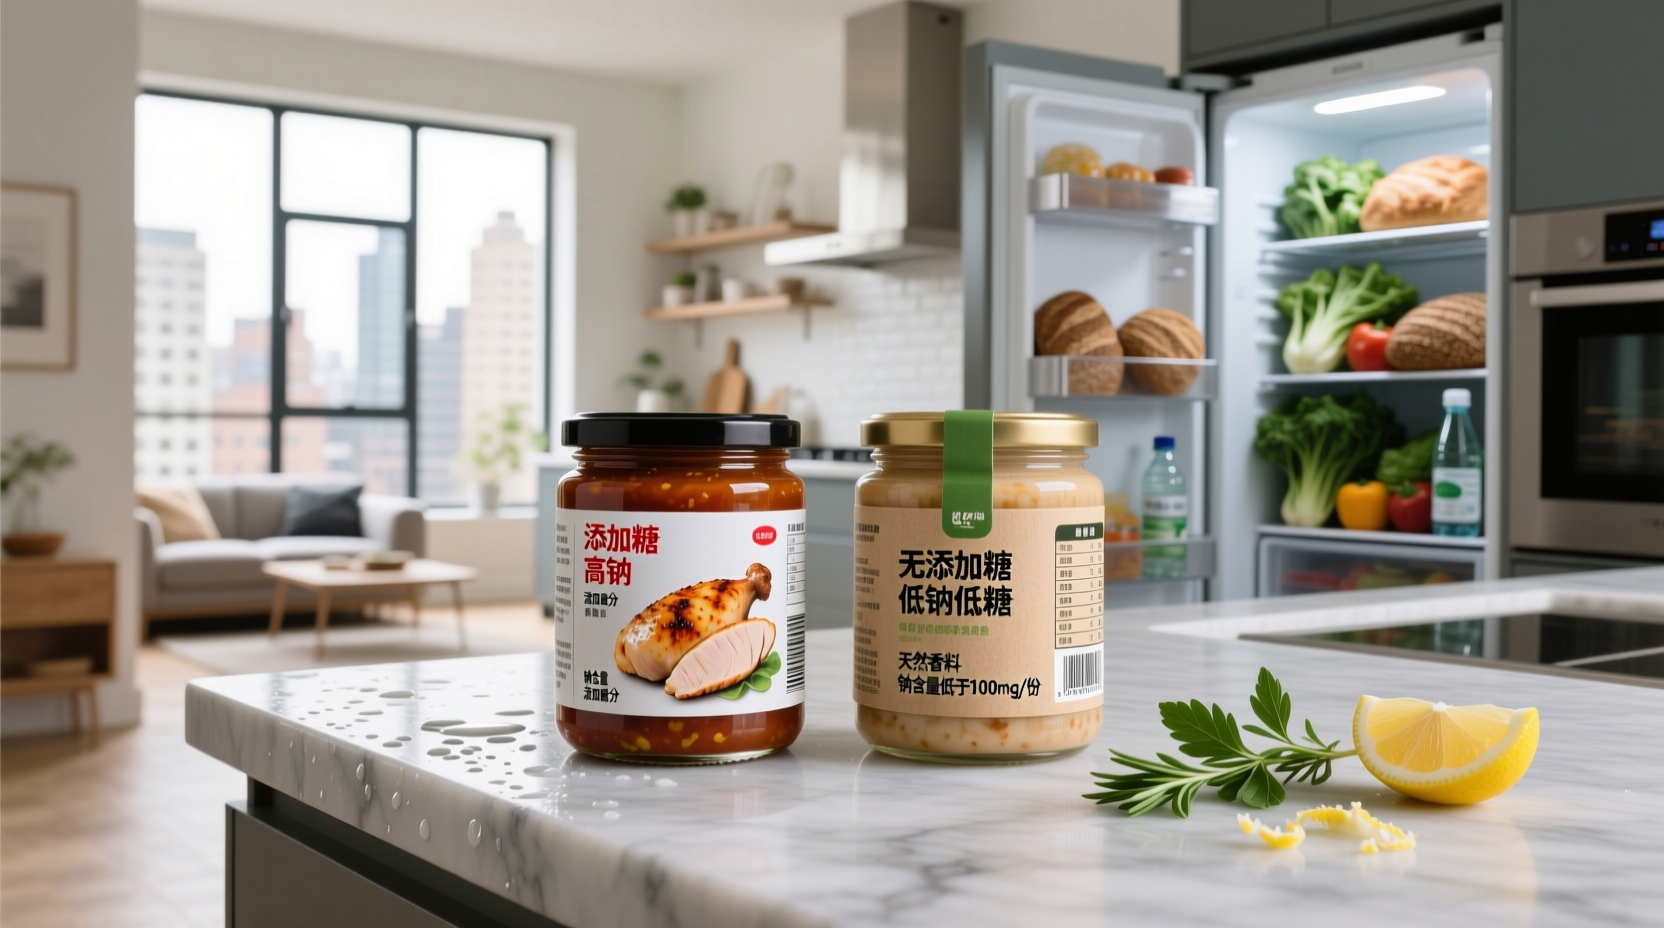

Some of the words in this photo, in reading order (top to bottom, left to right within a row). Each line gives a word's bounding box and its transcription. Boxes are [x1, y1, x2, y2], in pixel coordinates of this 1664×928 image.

[584, 523, 660, 555] 添加糖
[584, 556, 632, 586] 高钠
[898, 549, 1013, 581] 无添加糖
[898, 584, 1013, 617] 低钠低糖
[898, 651, 961, 673] 天然香料
[897, 673, 1041, 699] 钠含量低于100mg/份
